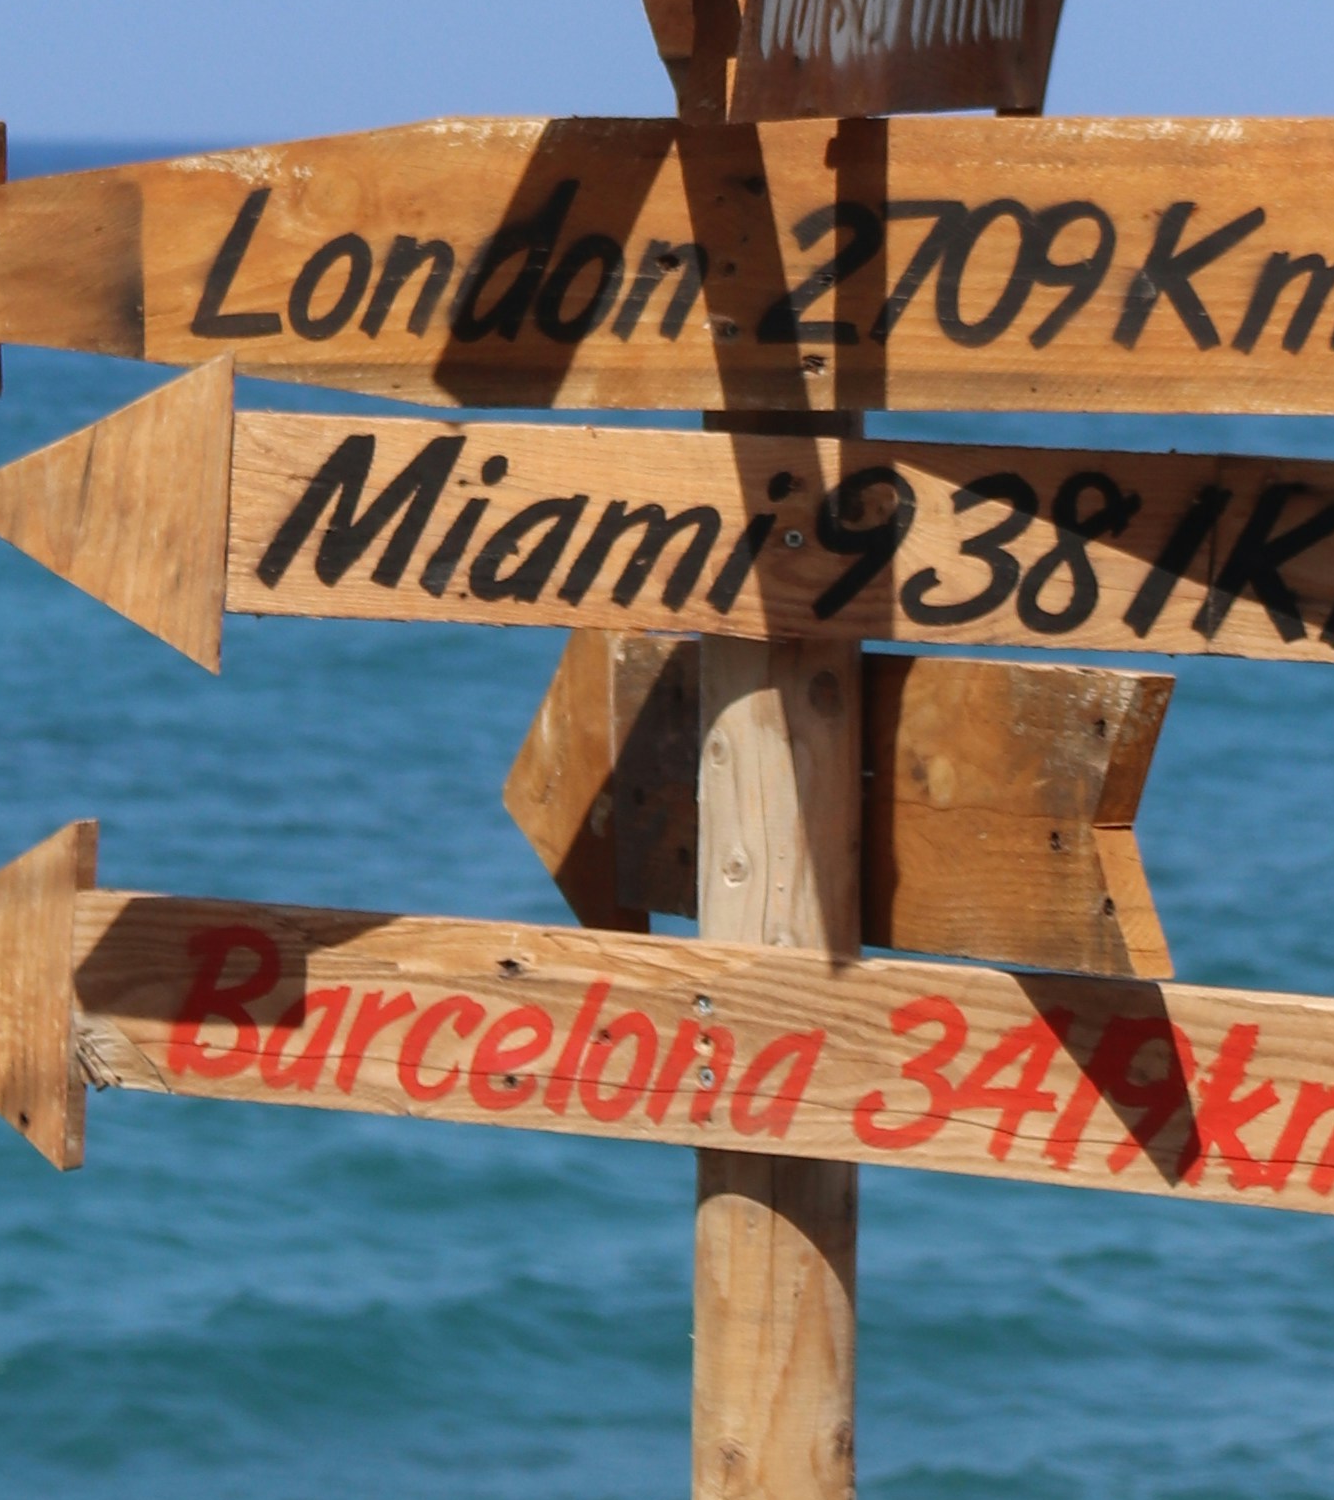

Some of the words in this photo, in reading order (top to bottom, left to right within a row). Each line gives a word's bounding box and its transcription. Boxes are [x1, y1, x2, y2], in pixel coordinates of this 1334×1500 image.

[189, 172, 712, 346] London
[255, 431, 801, 616] Miami
[167, 921, 827, 1142] Barcelona
